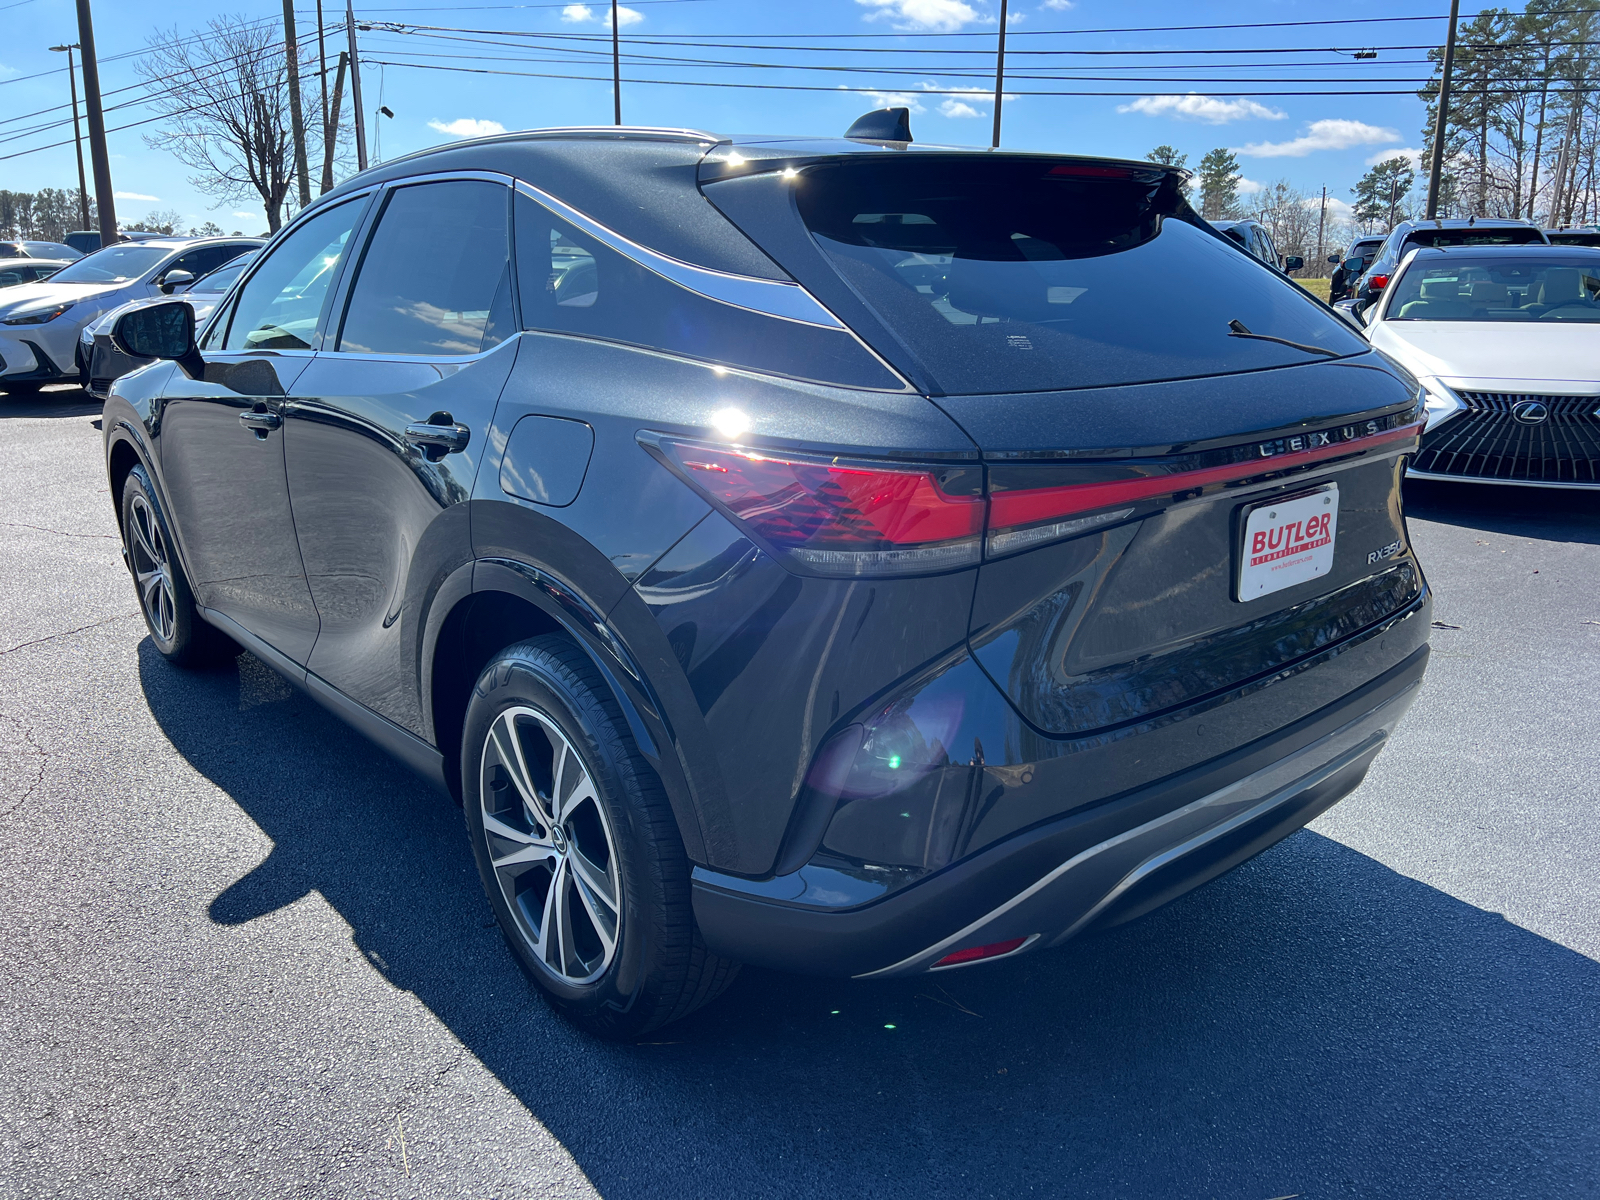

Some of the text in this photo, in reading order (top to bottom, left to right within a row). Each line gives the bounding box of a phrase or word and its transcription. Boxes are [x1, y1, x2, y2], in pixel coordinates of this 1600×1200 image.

[1259, 420, 1377, 457] LEXUS
[1308, 536, 1331, 549] GROUP
[1366, 539, 1402, 565] RX350
